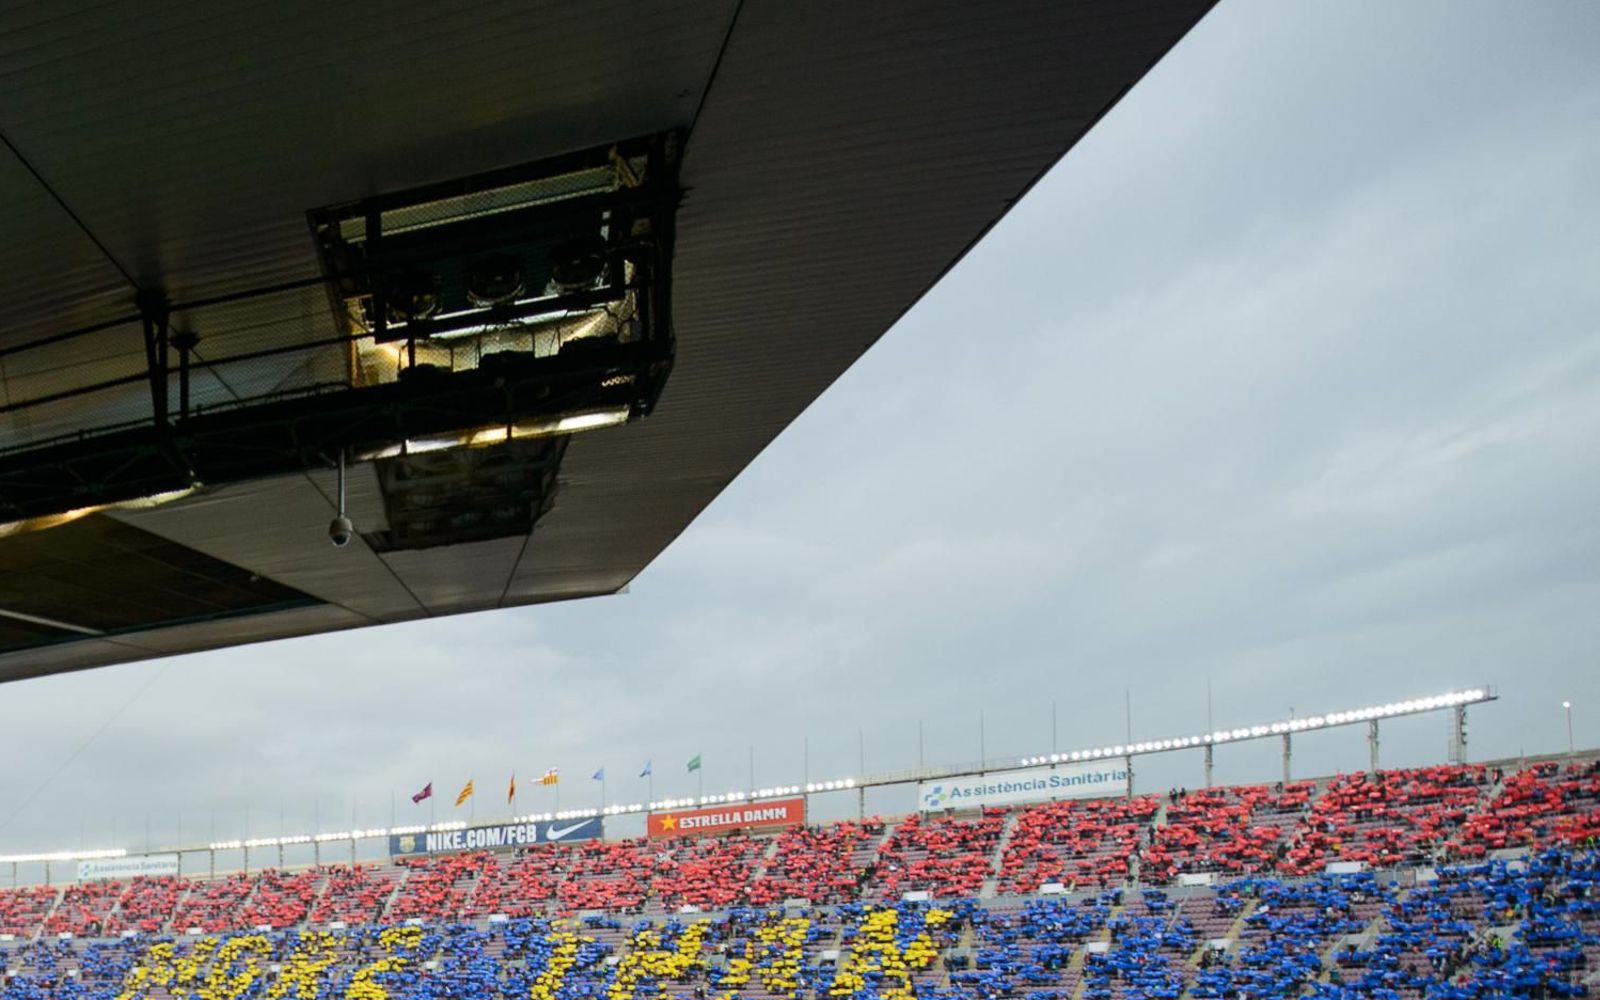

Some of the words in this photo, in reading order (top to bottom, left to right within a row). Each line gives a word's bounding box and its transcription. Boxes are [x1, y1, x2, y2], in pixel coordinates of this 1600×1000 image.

[950, 779, 1047, 798] Assistència
[1049, 771, 1127, 788] Sanitària
[679, 812, 742, 828] ESTRELLA
[744, 807, 787, 822] DAMM
[426, 824, 537, 851] NIKE.COM/FCB
